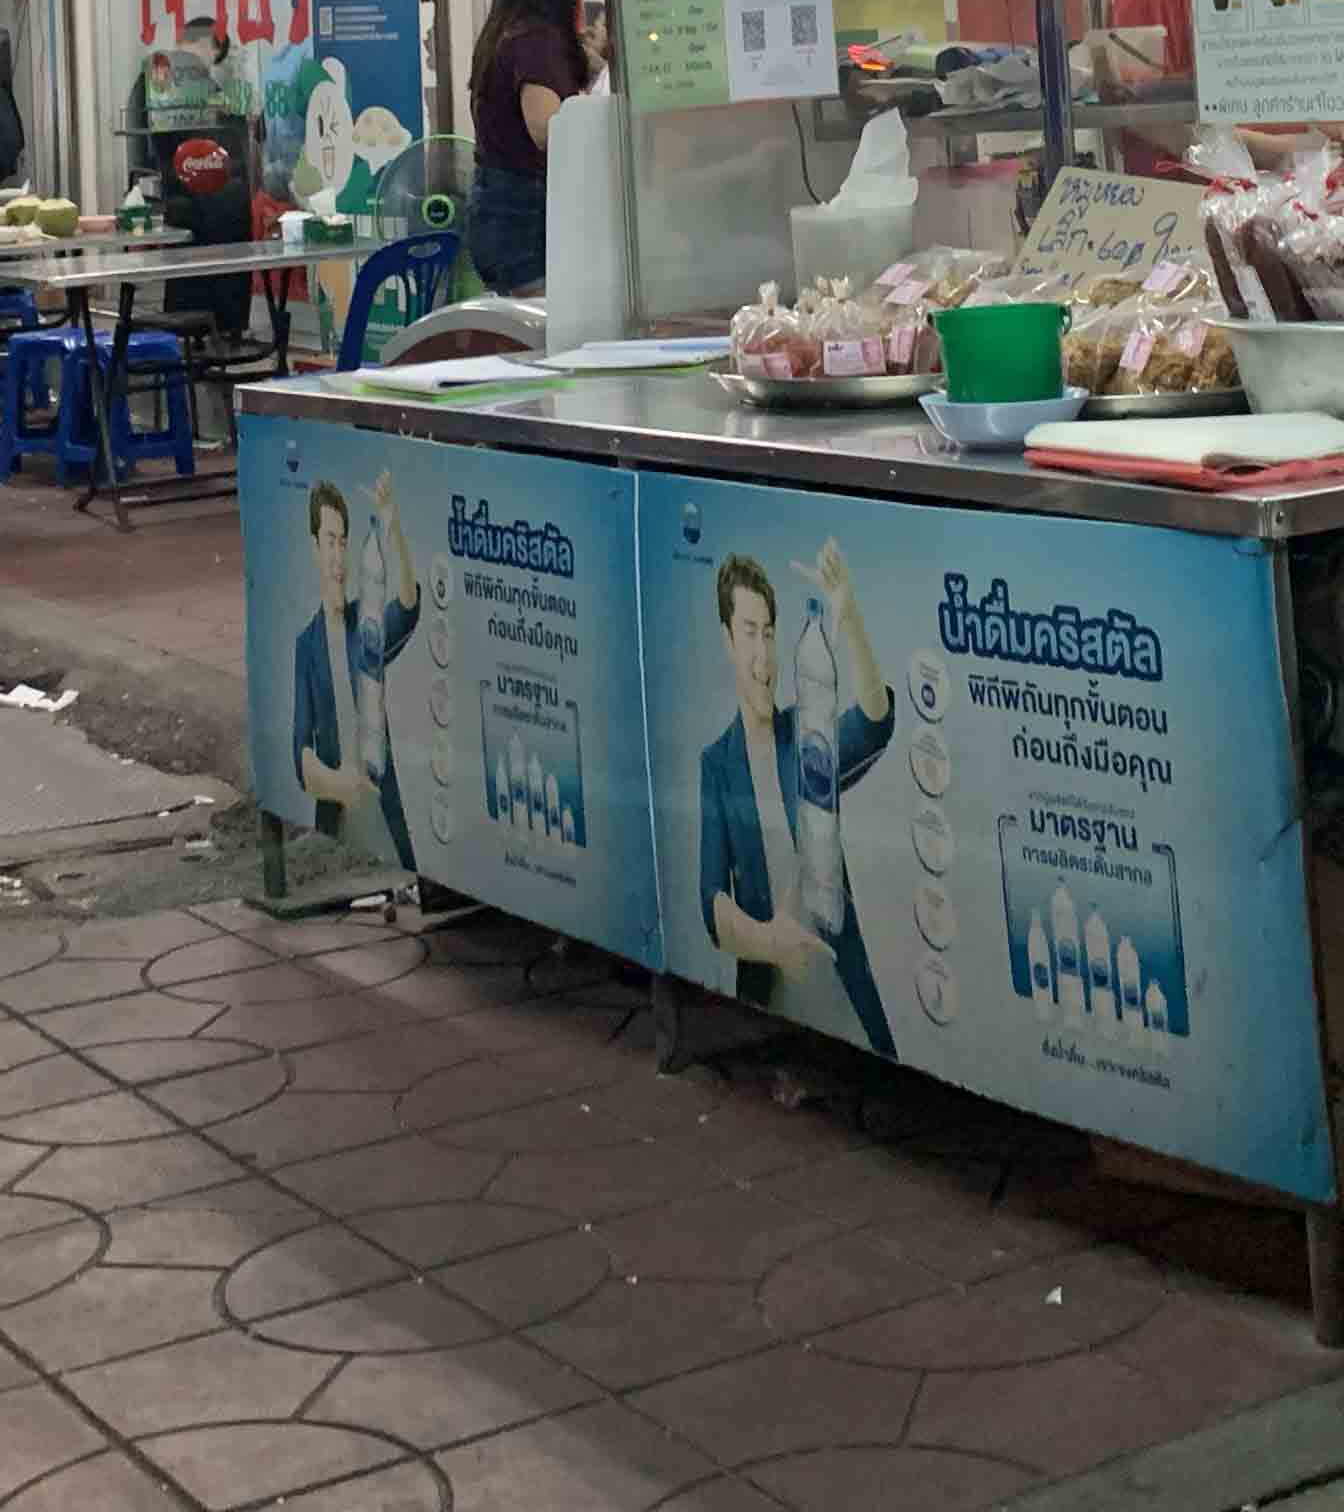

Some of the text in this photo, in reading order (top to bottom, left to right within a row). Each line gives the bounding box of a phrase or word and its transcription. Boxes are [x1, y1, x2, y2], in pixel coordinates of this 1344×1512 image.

[937, 572, 1164, 682] น้ำดื่มคริสตัล
[967, 672, 1169, 736] พิถีพิถันทุกขั้นตอน
[1011, 727, 1173, 793] ก่อนถึงมือคุณ
[1028, 807, 1139, 854] มาตรฐาน
